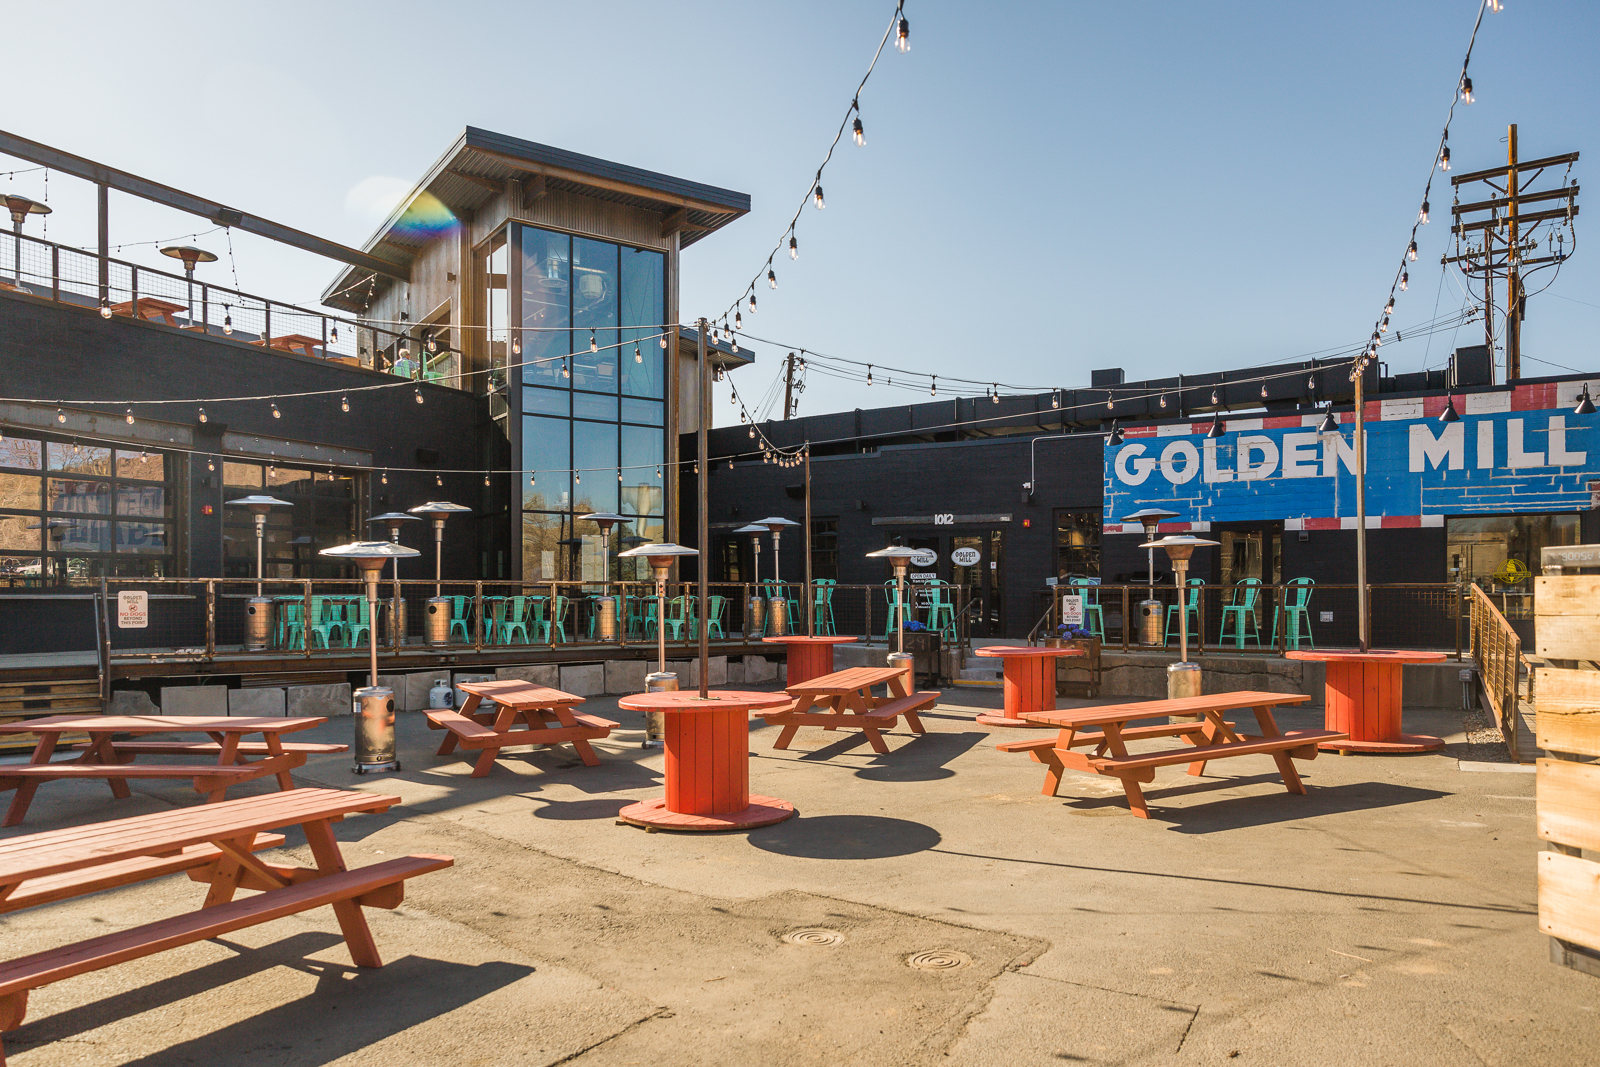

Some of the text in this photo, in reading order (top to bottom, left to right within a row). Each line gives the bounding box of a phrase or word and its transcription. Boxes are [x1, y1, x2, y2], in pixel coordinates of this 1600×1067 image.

[1115, 415, 1587, 486] GOLDEN MILL
[934, 513, 954, 525] 1012
